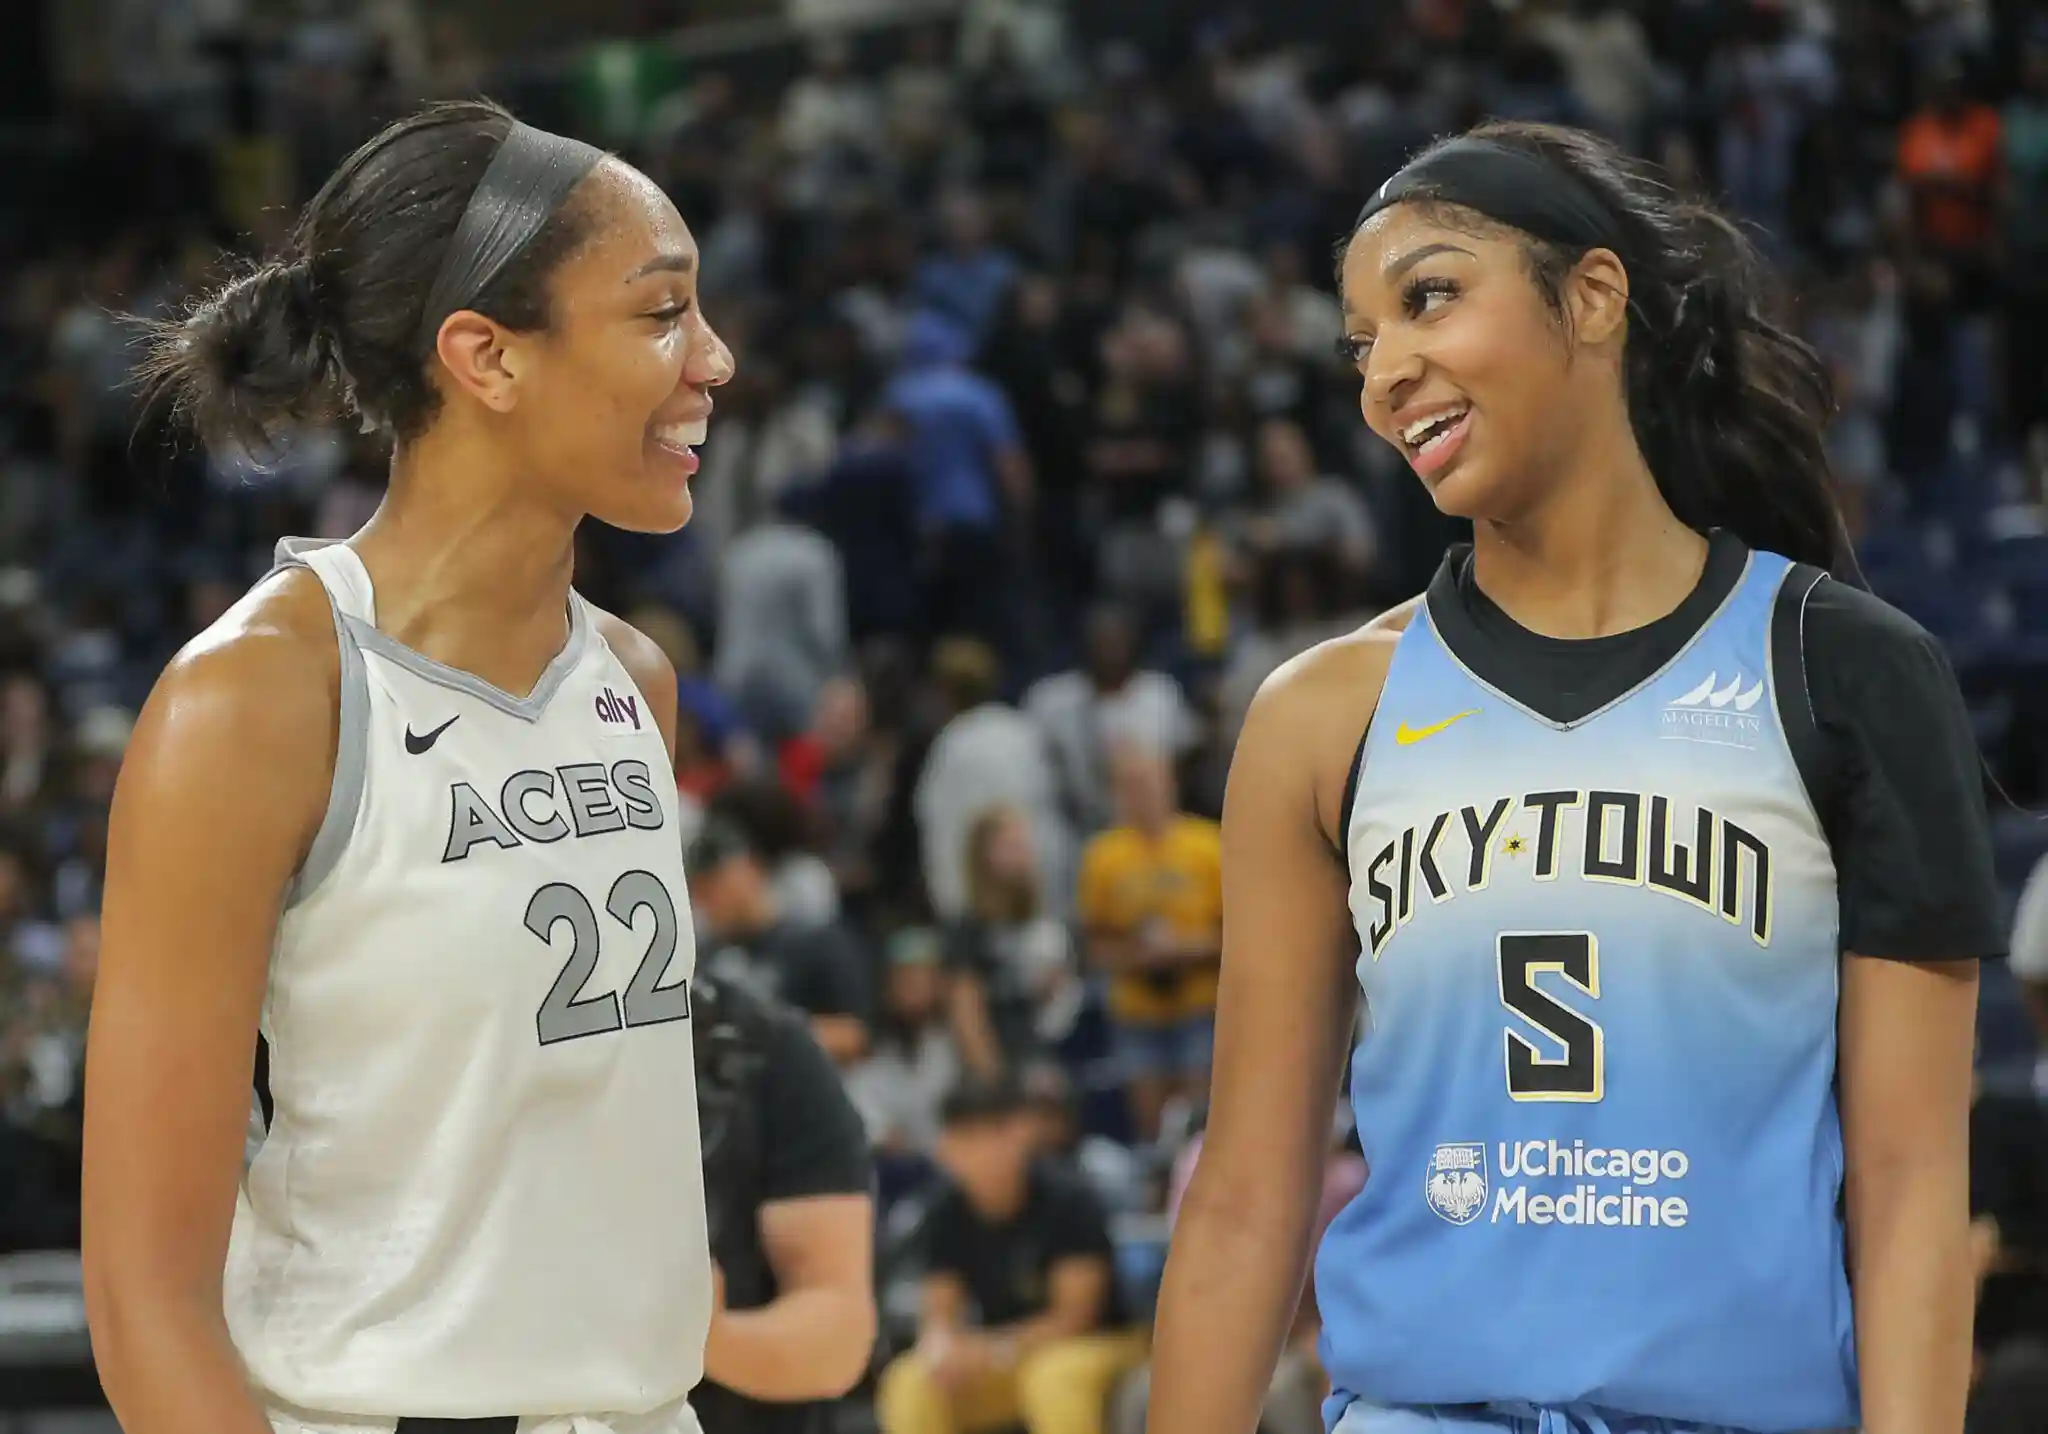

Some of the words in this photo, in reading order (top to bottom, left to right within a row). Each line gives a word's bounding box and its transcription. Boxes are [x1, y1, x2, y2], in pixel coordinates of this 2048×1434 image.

[595, 688, 641, 730] ally
[1661, 711, 1760, 733] MAGELLAN
[441, 760, 664, 863] ACES
[523, 869, 690, 1047] 22
[1496, 930, 1605, 1103] 5
[1498, 1139, 1689, 1185] UChicago
[1490, 1184, 1689, 1228] Medicine
